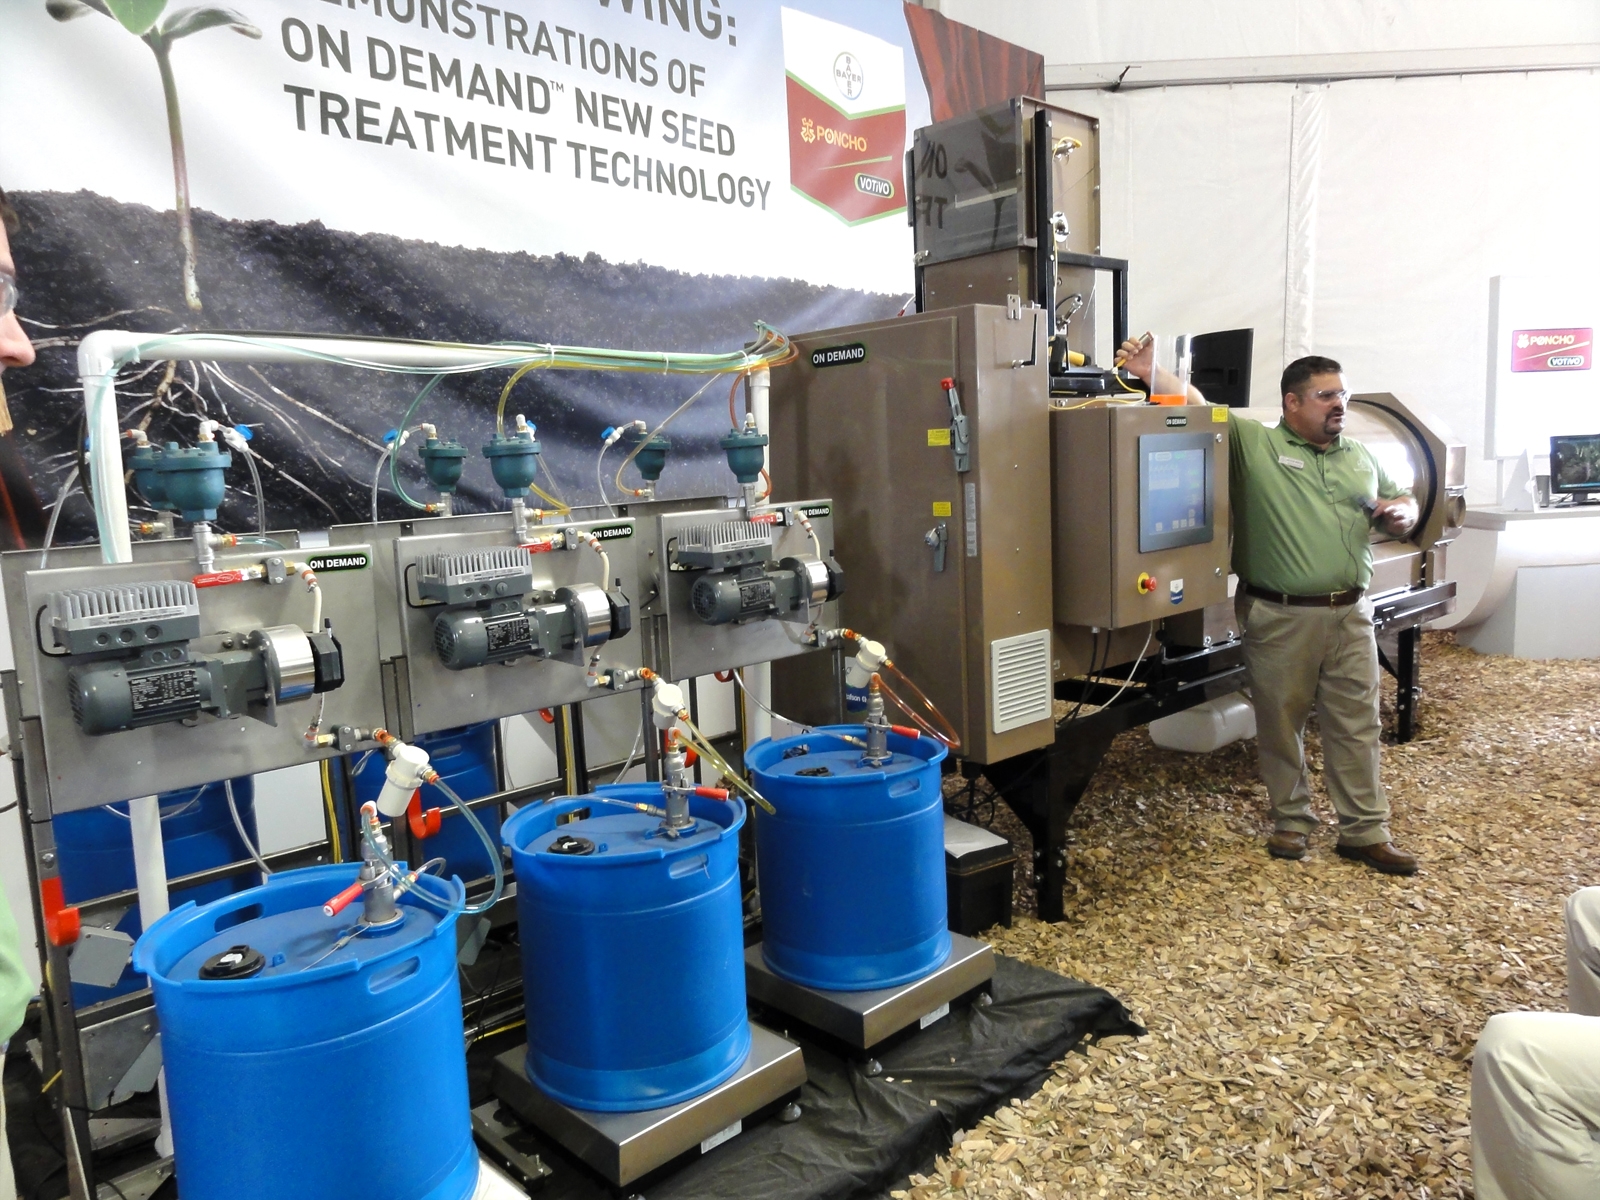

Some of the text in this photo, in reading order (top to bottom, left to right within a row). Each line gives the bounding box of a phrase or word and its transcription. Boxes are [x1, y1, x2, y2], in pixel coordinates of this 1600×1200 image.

[667, 58, 706, 98] OF
[281, 17, 352, 74] ON
[574, 87, 653, 138] NEW
[661, 109, 736, 157] SEED
[283, 83, 771, 211] TREATMENT TECHNOLOGY
[816, 125, 867, 152] PONCHO
[1530, 334, 1575, 346] PONCHO
[812, 347, 865, 364] ON DEMAND
[808, 507, 830, 516] DEMAND
[592, 527, 632, 538] ON DEMAND
[310, 556, 367, 569] ON DEMAND
